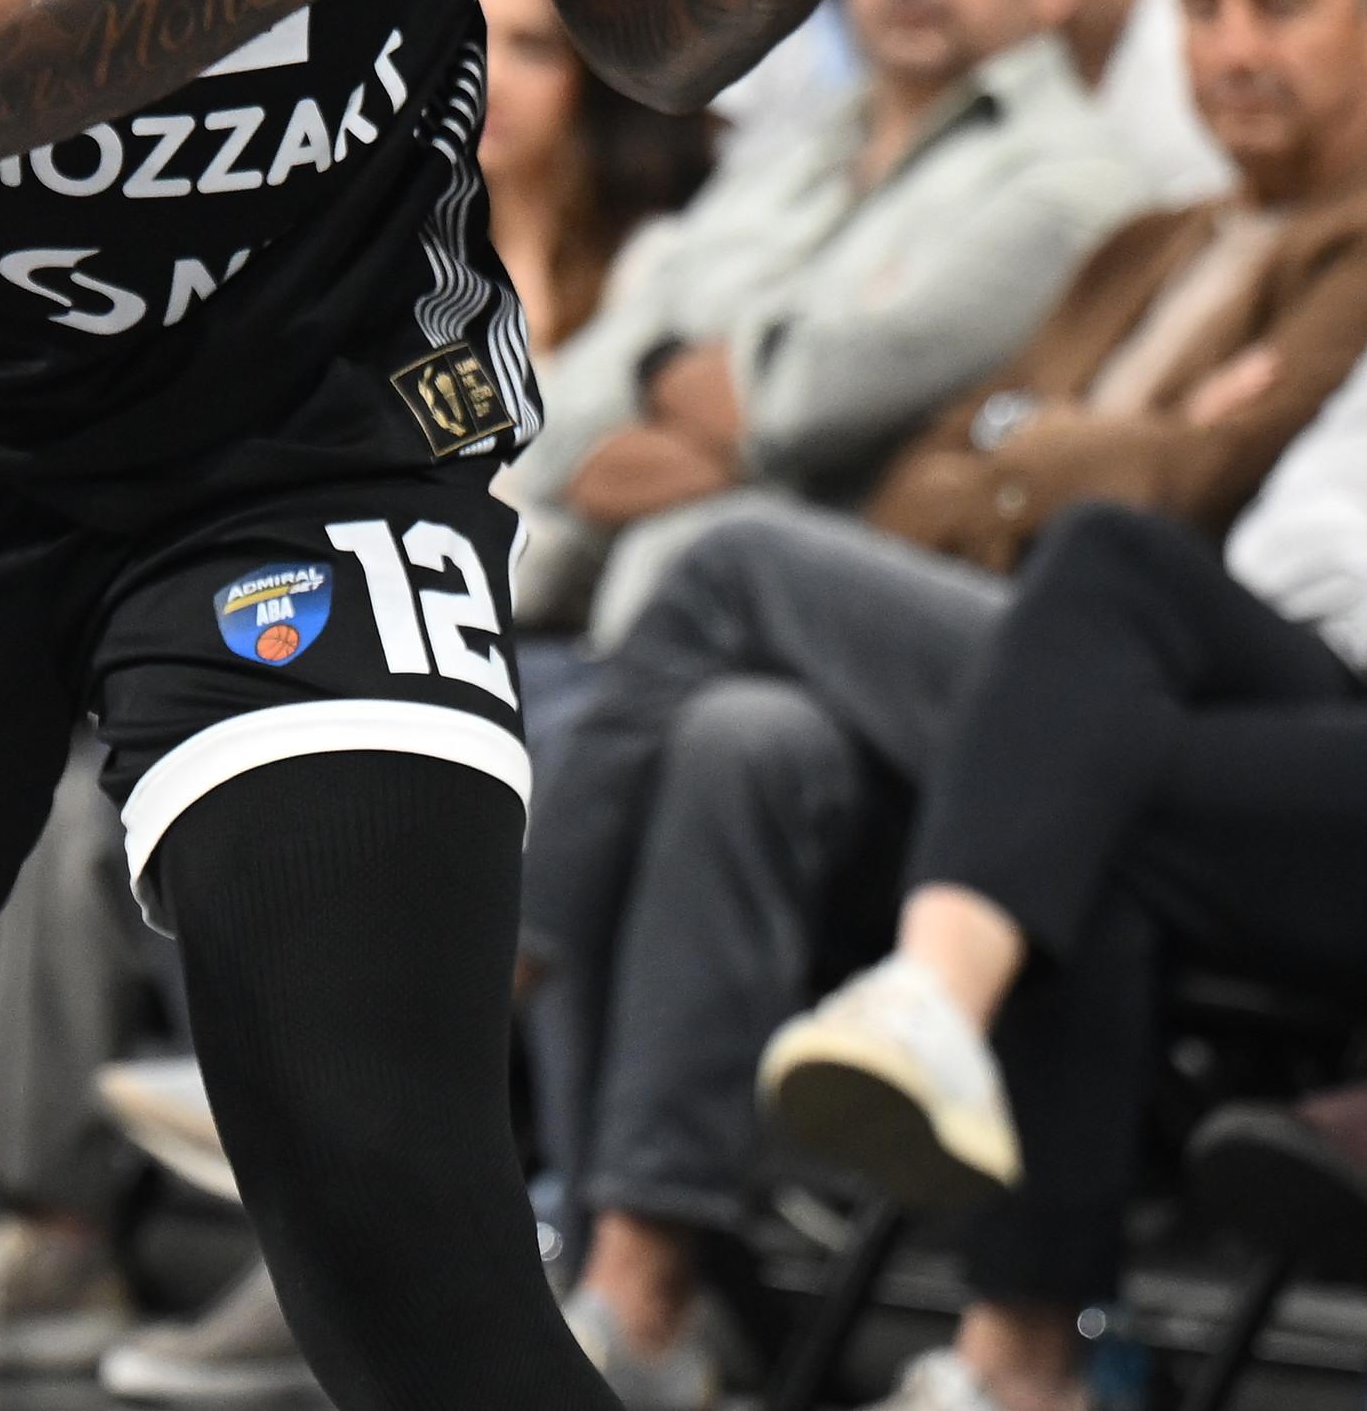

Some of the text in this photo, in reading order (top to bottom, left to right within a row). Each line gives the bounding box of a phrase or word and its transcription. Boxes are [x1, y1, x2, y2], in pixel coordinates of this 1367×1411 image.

[227, 566, 324, 602] ADMIRAL
[256, 595, 294, 627] ABA
[324, 518, 518, 712] 12
